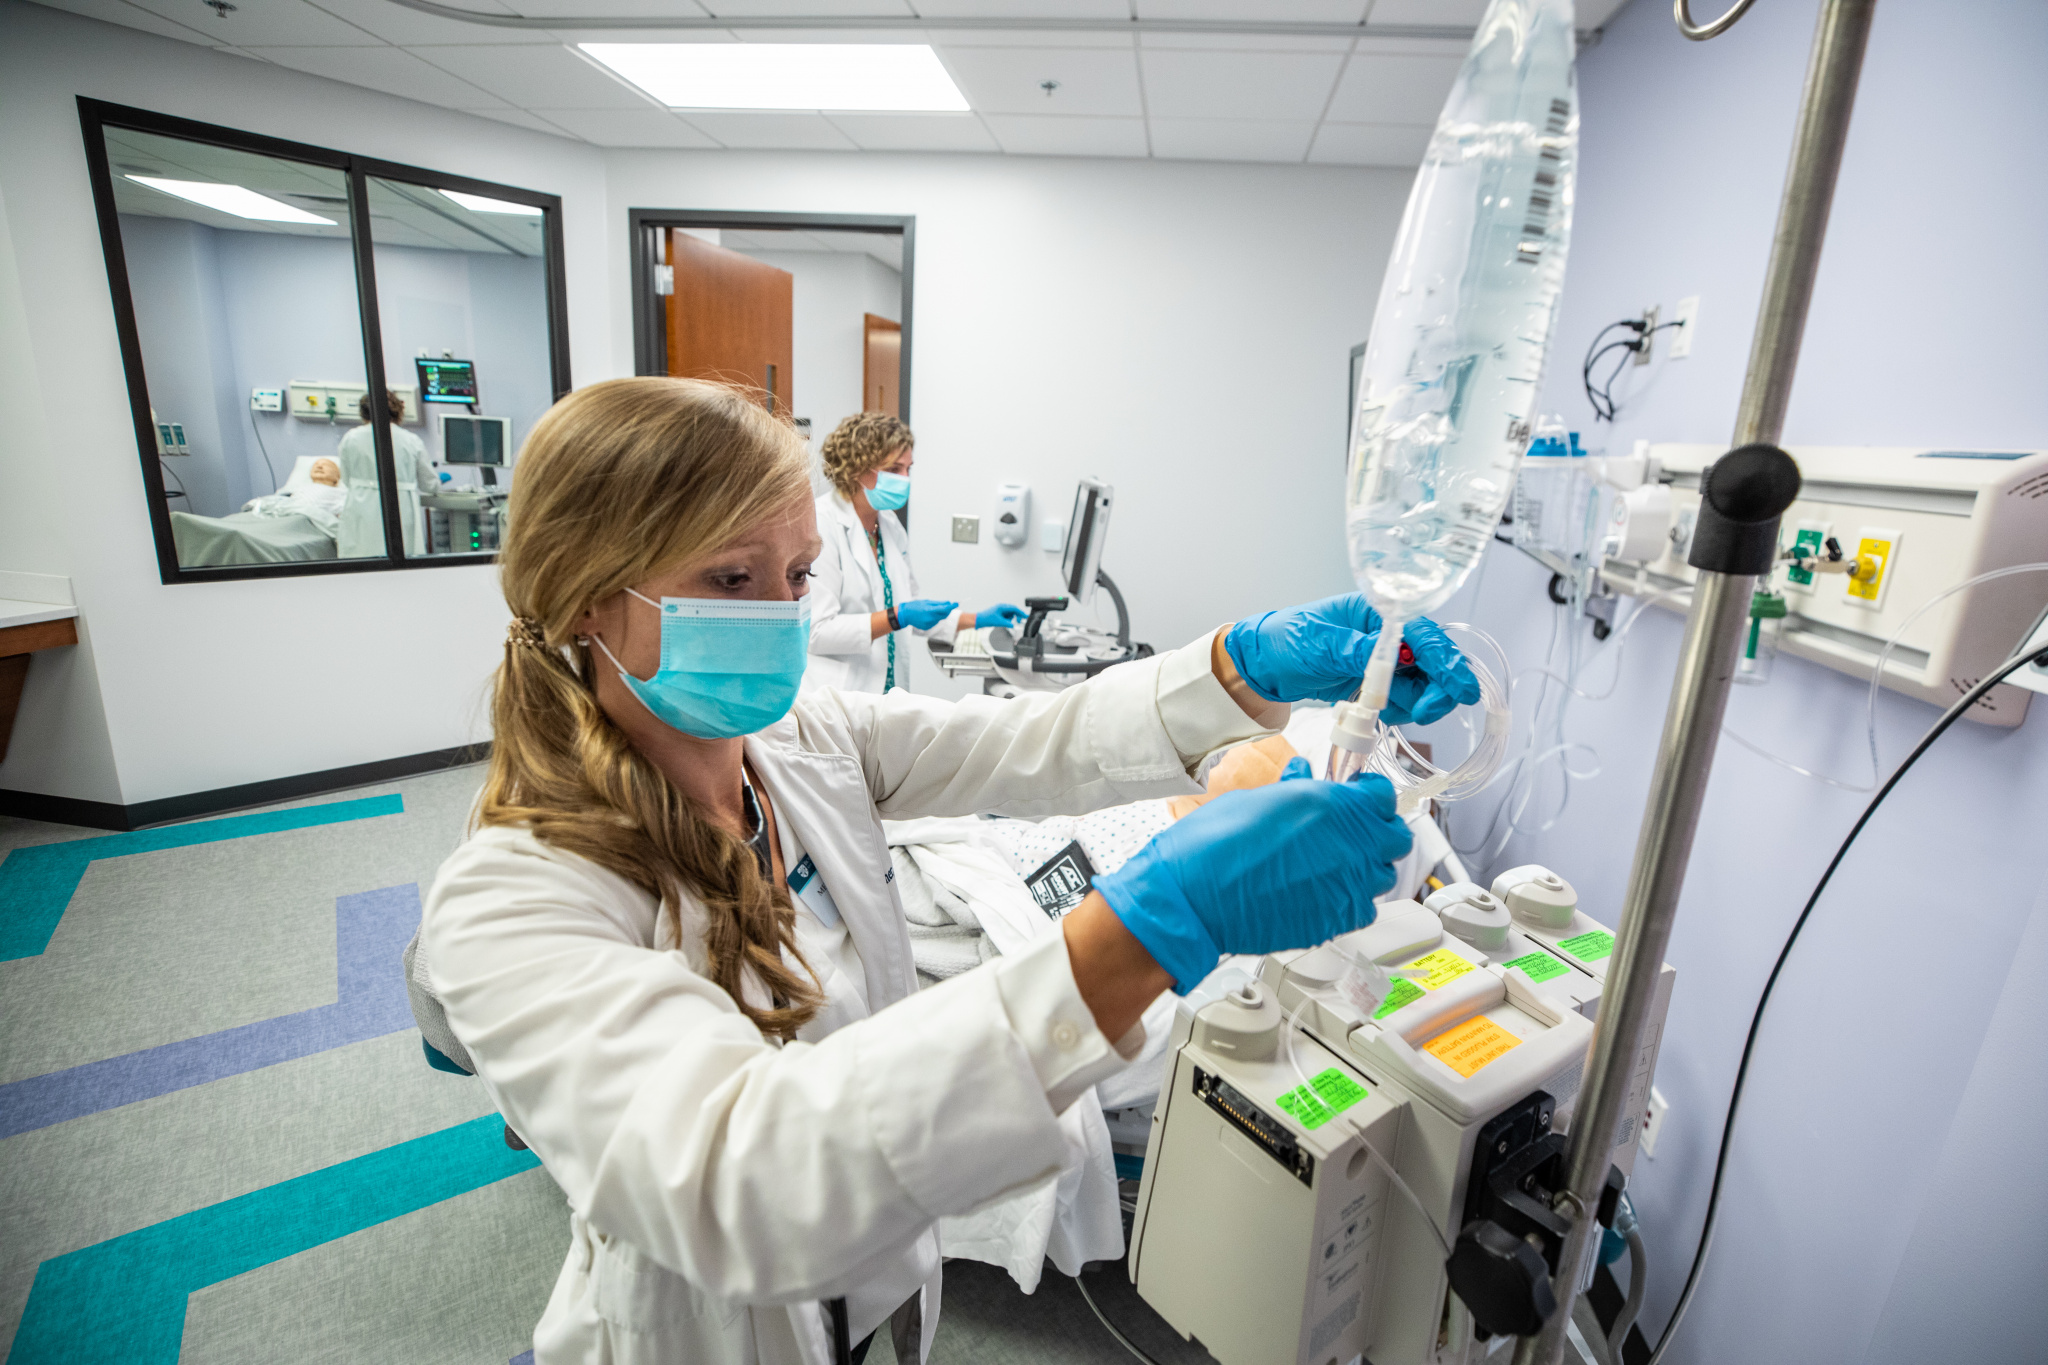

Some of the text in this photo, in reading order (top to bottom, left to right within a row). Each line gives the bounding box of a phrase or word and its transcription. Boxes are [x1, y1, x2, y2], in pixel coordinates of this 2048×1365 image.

[1413, 954, 1437, 967] BATTERY
[1458, 1026, 1486, 1043] MAINTAIN
[1483, 1022, 1494, 1030] TO
[1487, 1032, 1501, 1043] STAY
[1436, 1038, 1459, 1056] BATTERY
[1460, 1038, 1488, 1057] PLUGGED
[1469, 1042, 1511, 1069] THIS UNIT MUST
